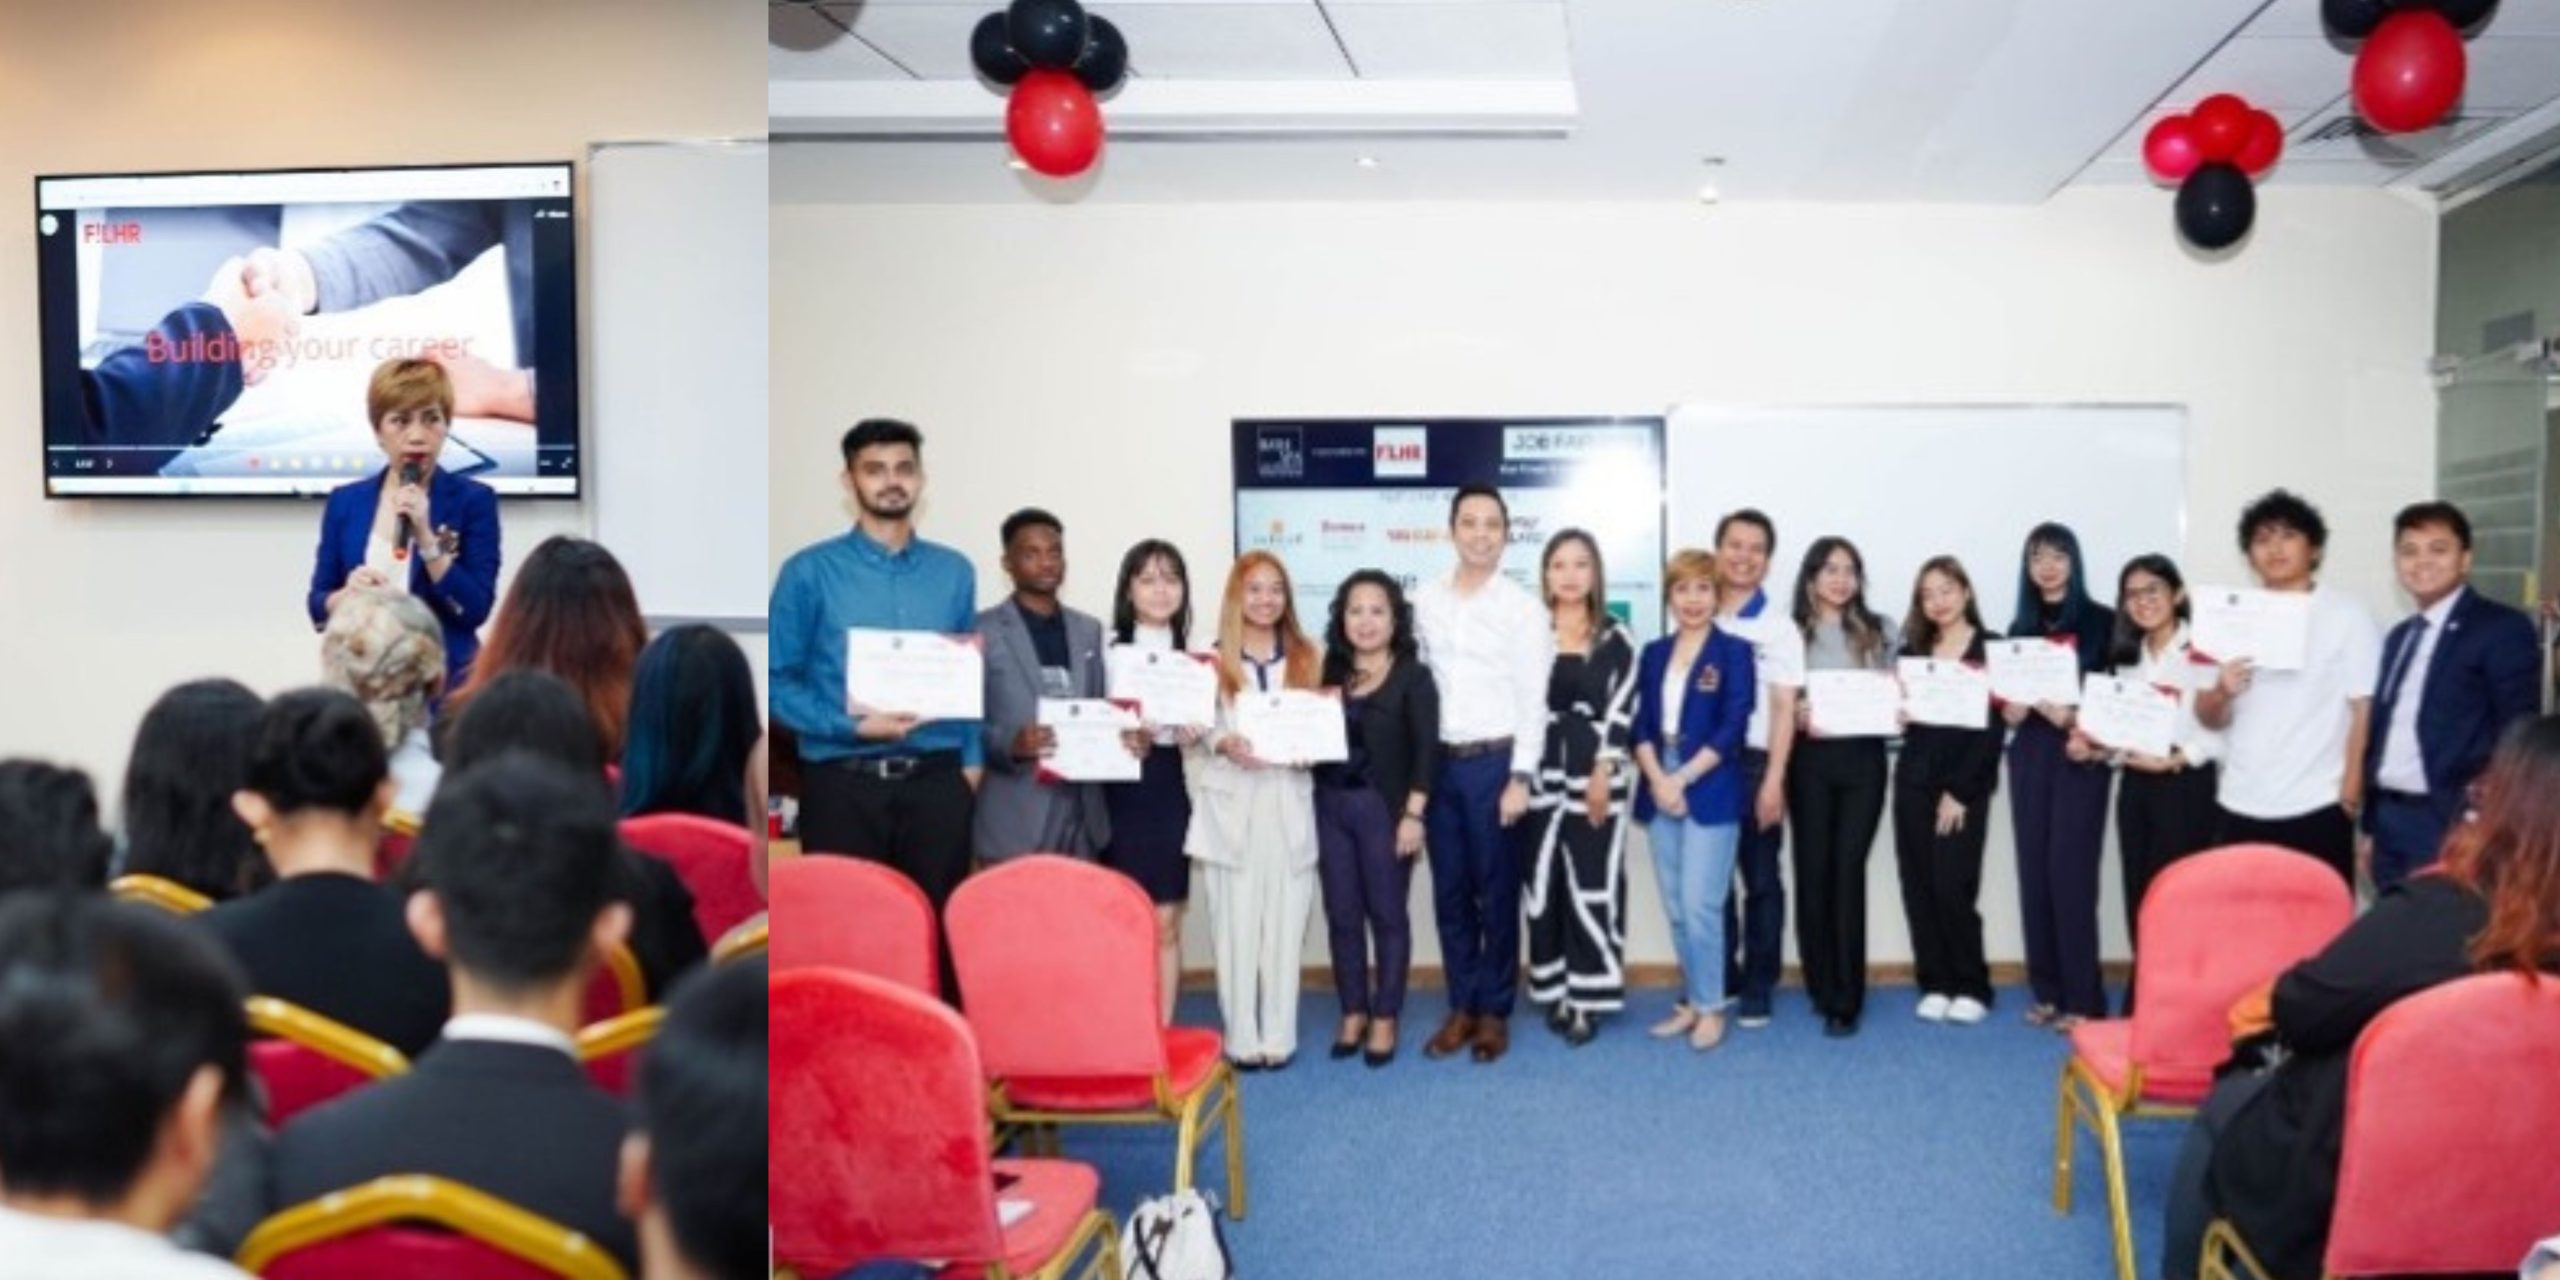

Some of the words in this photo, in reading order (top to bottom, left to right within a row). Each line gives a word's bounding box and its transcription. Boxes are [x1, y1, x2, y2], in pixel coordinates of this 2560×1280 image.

[146, 329, 277, 369] Building
[284, 336, 356, 368] your
[369, 334, 475, 360] career
